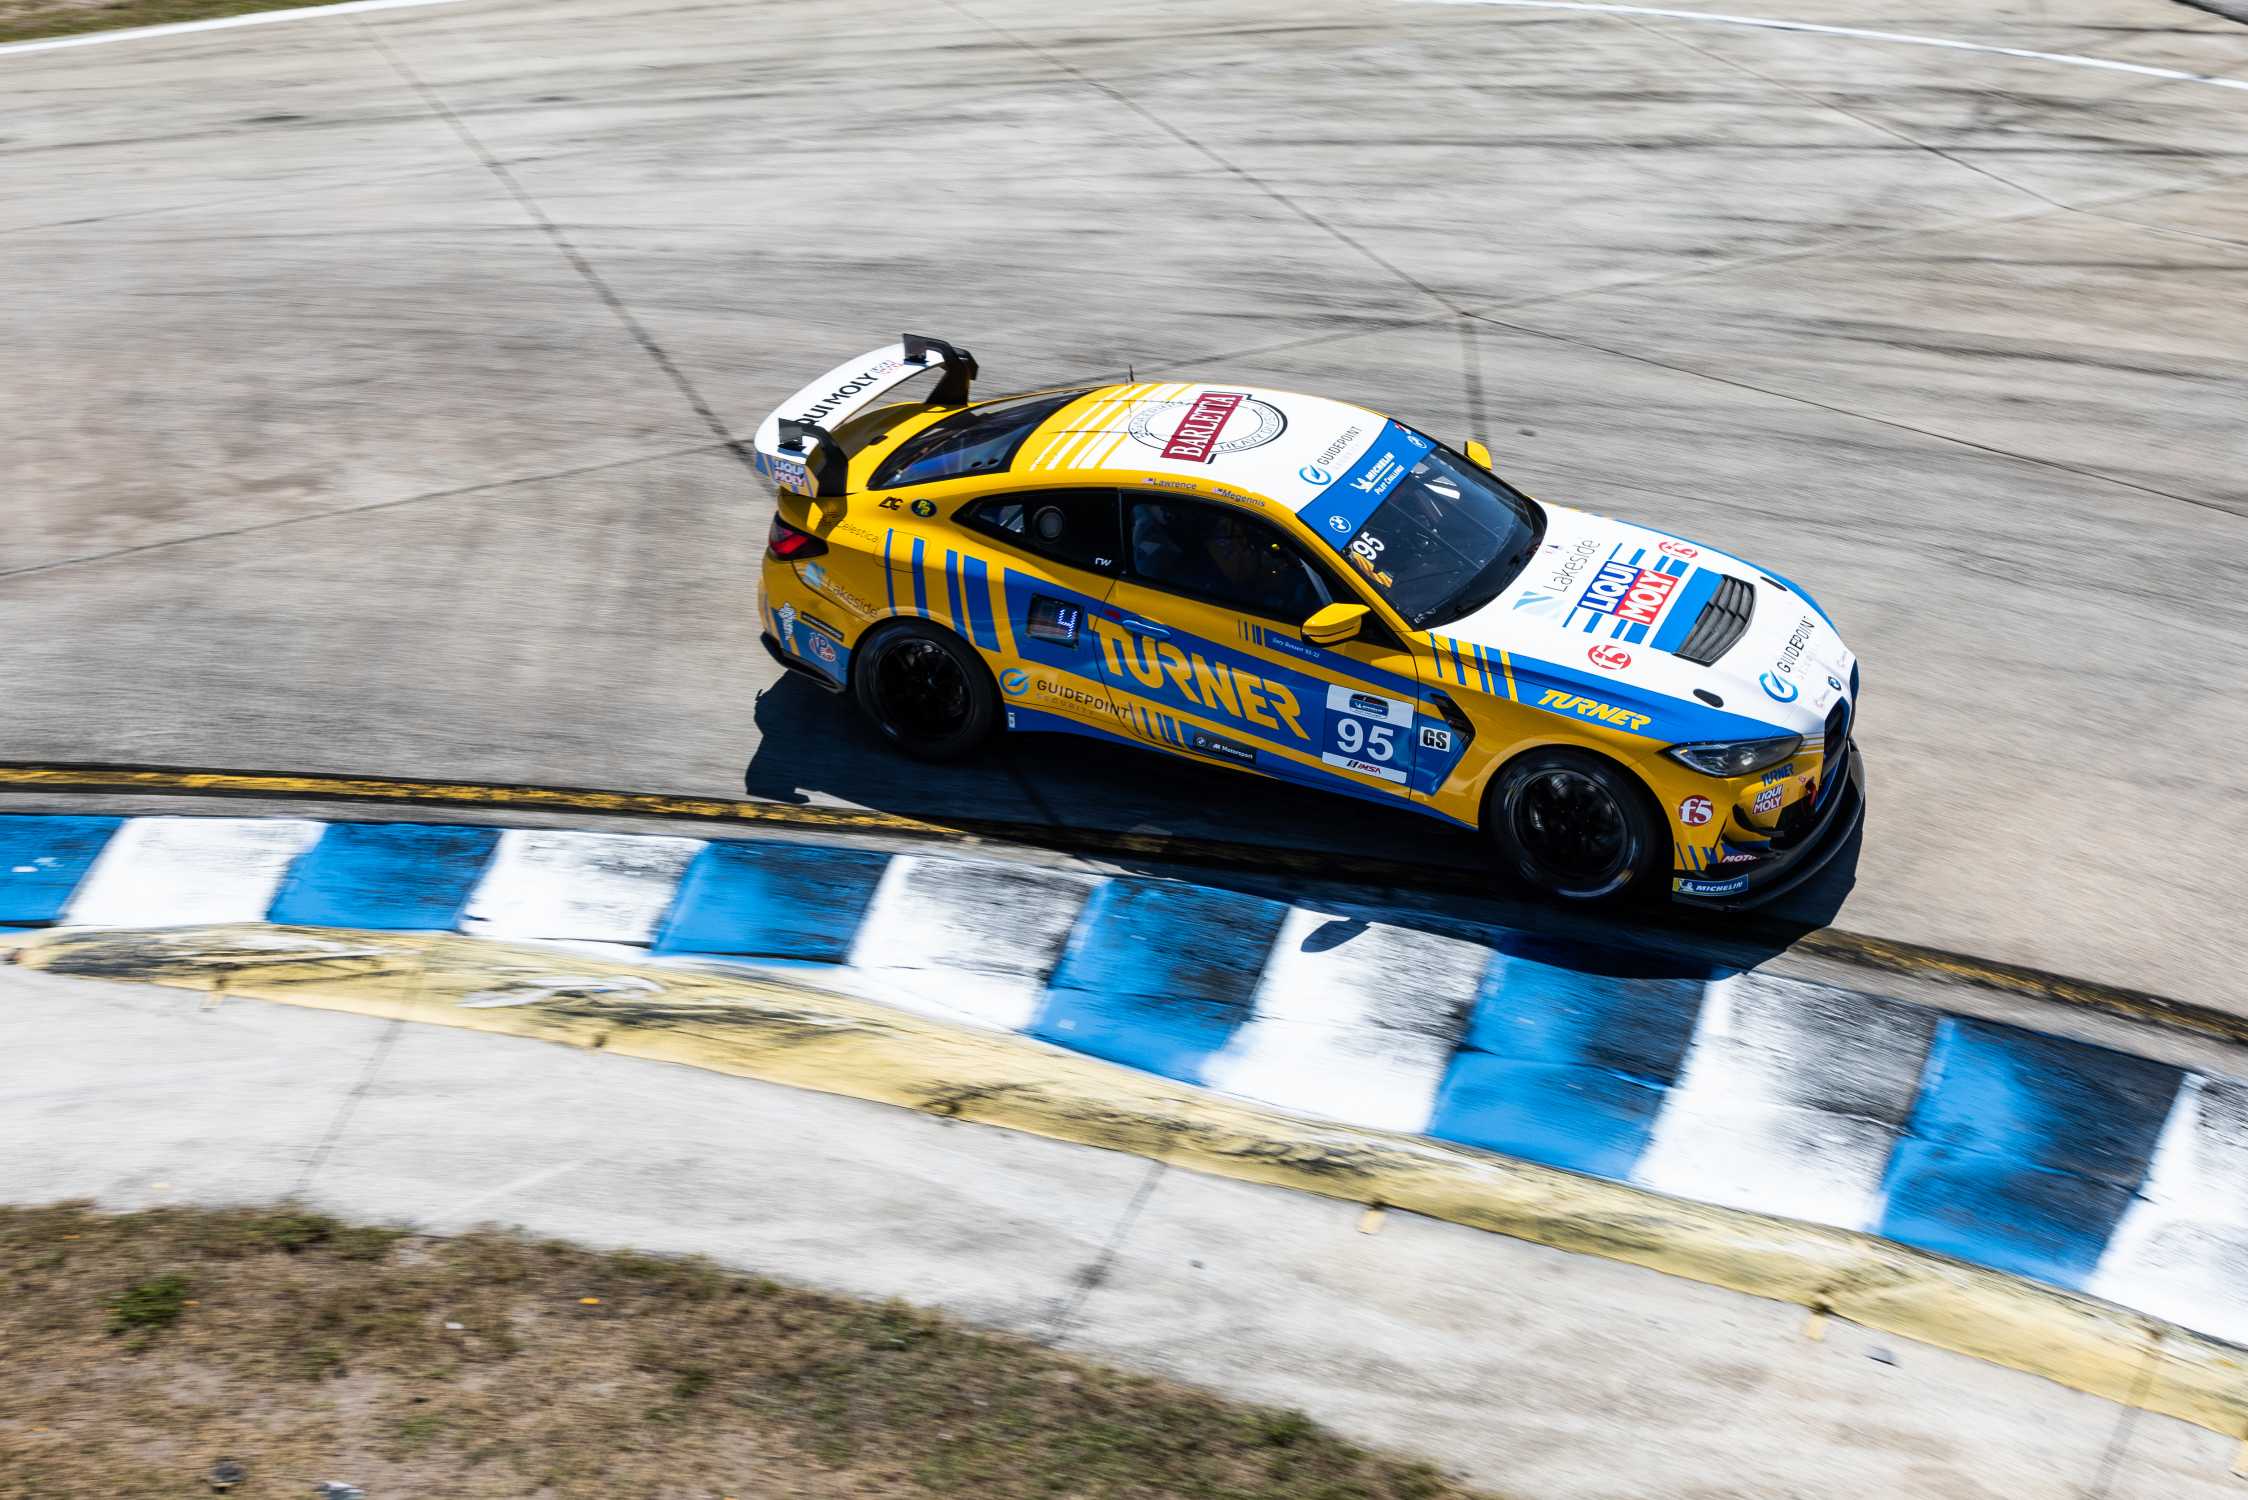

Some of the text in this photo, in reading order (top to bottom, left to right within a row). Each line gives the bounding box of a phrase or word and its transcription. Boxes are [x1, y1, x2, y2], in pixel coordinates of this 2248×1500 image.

[822, 372, 879, 405] MOLY
[1168, 395, 1239, 458] BARLETTA
[1316, 425, 1363, 466] GUIDEPOINT
[1352, 531, 1385, 561] 95
[1543, 539, 1601, 593] Lakeside
[1580, 562, 1639, 611] LIQUI
[1617, 569, 1676, 623] MOLY
[1057, 608, 1078, 638] 4
[1776, 614, 1815, 674] GUIDEPOIN
[1088, 613, 1311, 741] TURNER
[1036, 679, 1131, 720] GUIDEPOINT
[1537, 689, 1652, 731] TURNER
[1337, 718, 1394, 762] 95
[1422, 729, 1448, 750] GS
[1357, 762, 1382, 775] IMSA
[1679, 798, 1713, 824] f5
[1753, 796, 1782, 814] MOLY
[1756, 784, 1783, 803] LIQUI
[1695, 881, 1743, 892] MICHELIN
